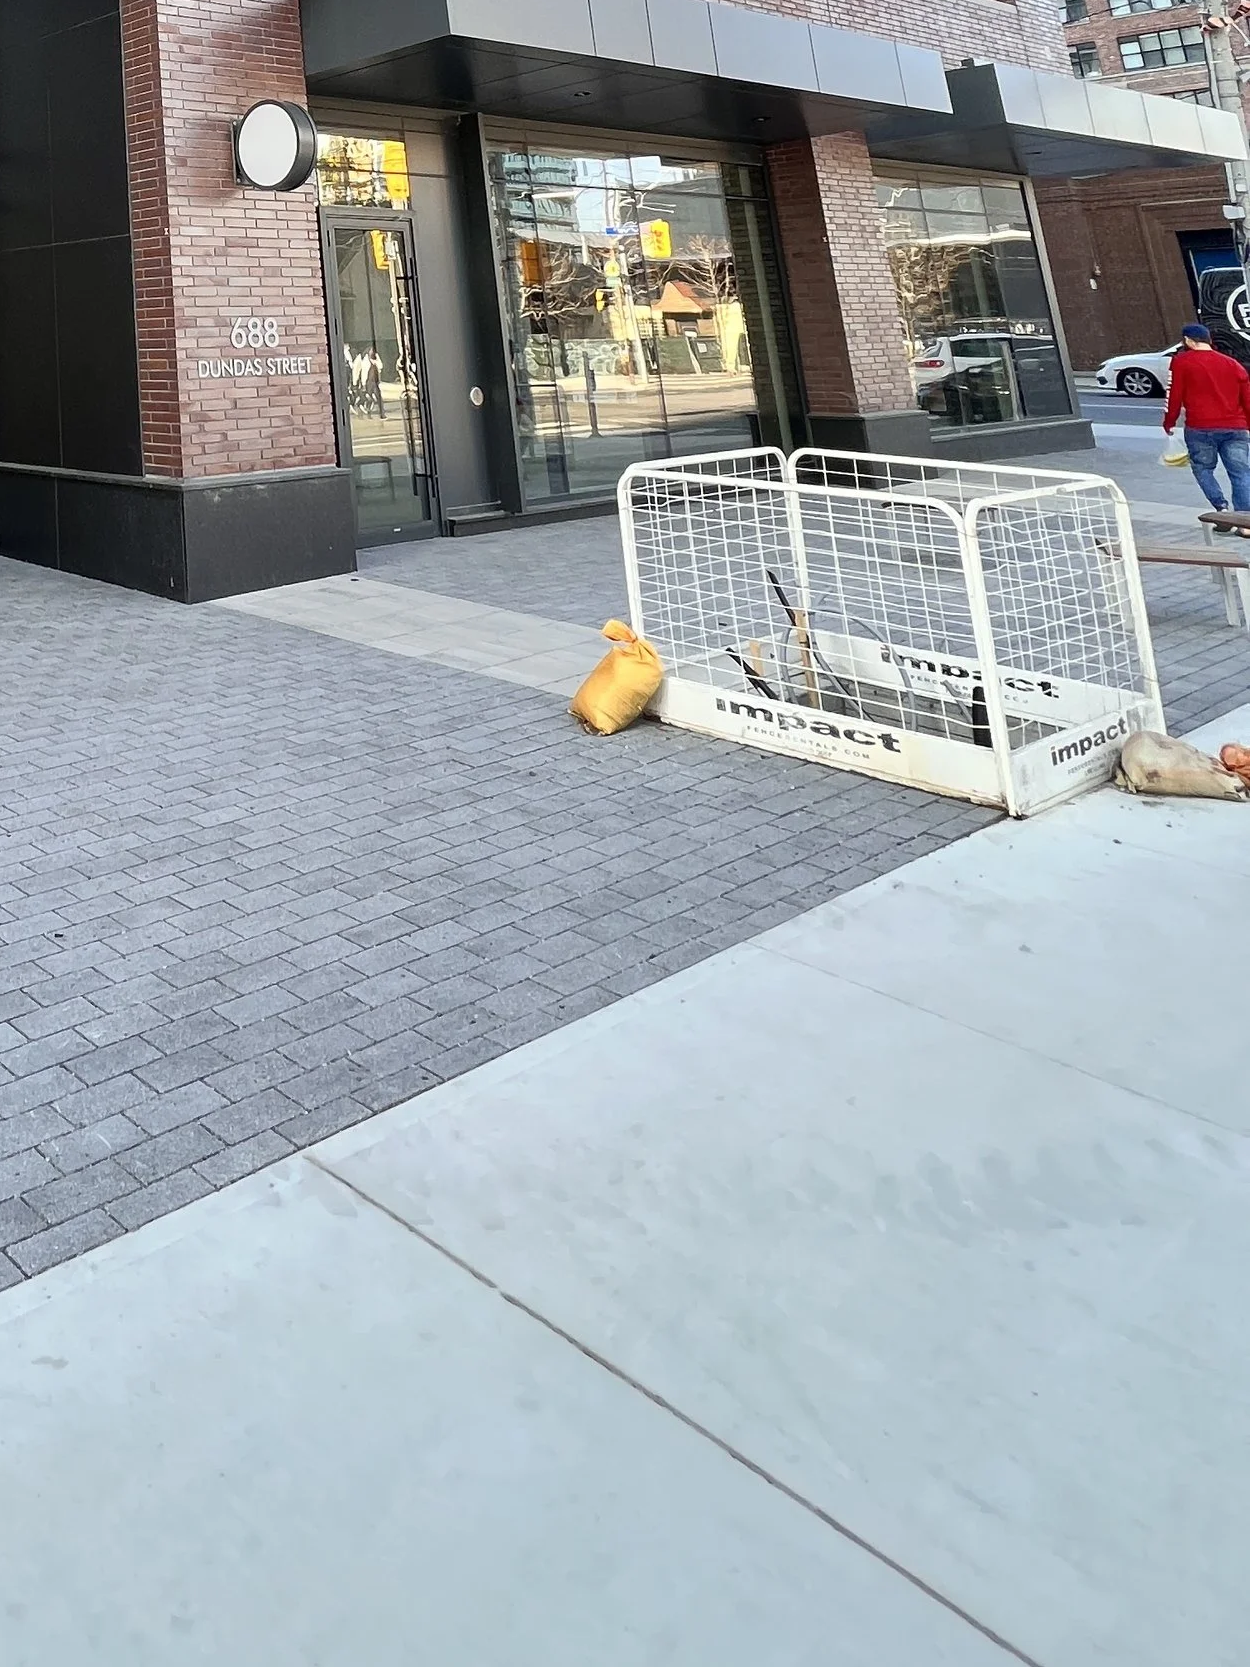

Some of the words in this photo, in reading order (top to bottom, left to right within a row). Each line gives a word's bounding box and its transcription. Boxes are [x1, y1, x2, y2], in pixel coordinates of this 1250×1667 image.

[230, 316, 280, 349] 688
[198, 358, 263, 379] DUNDAS
[266, 356, 313, 377] STREET
[880, 644, 1060, 700] impct
[715, 698, 902, 754] impact
[1050, 716, 1128, 767] impact
